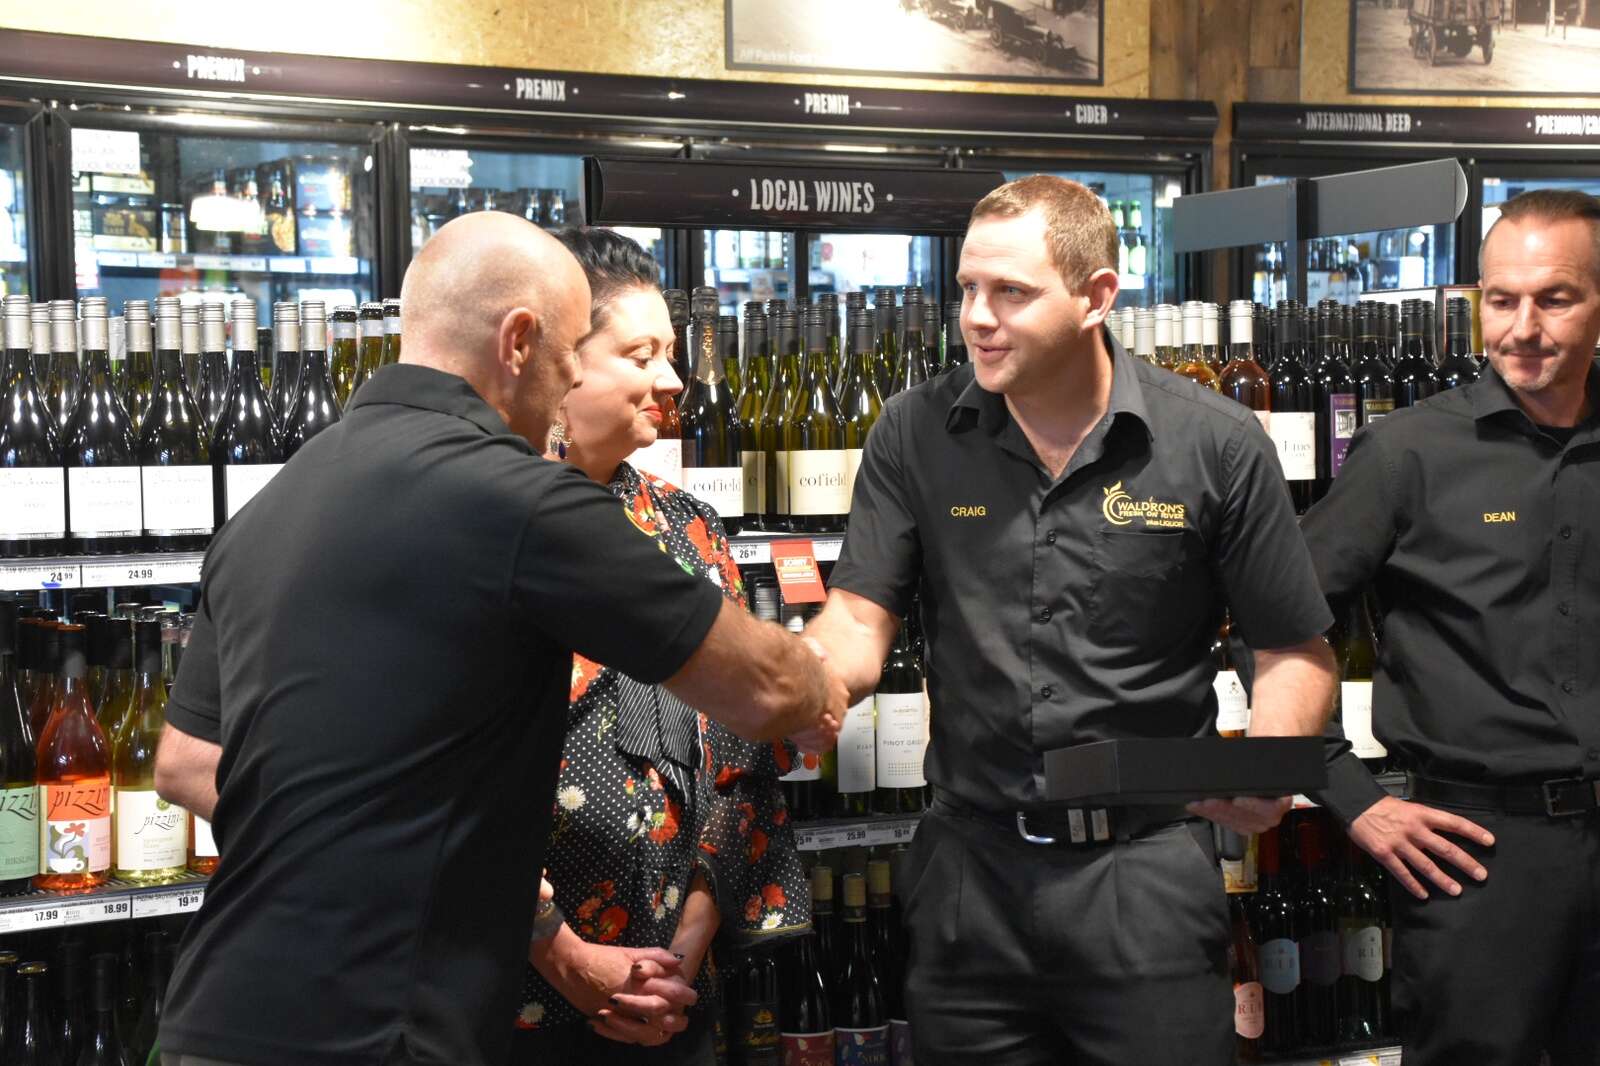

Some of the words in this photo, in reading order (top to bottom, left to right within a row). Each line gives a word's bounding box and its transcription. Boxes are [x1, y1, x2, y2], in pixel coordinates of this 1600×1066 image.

[187, 54, 246, 83] PREMIX
[516, 77, 566, 102] PREMIX
[804, 92, 850, 115] PREMIX
[1076, 104, 1108, 124] CIDER
[1306, 111, 1383, 132] INTERNATIONAL
[1385, 112, 1411, 133] BEER
[750, 179, 809, 211] LOCAL
[814, 180, 875, 214] WINES
[951, 505, 986, 517] CRAIG
[1117, 501, 1185, 514] WALDRON'S
[1483, 511, 1516, 523] DEAN
[128, 569, 153, 580] 24.99
[35, 910, 59, 922] 17.99
[103, 902, 129, 915] 18.99
